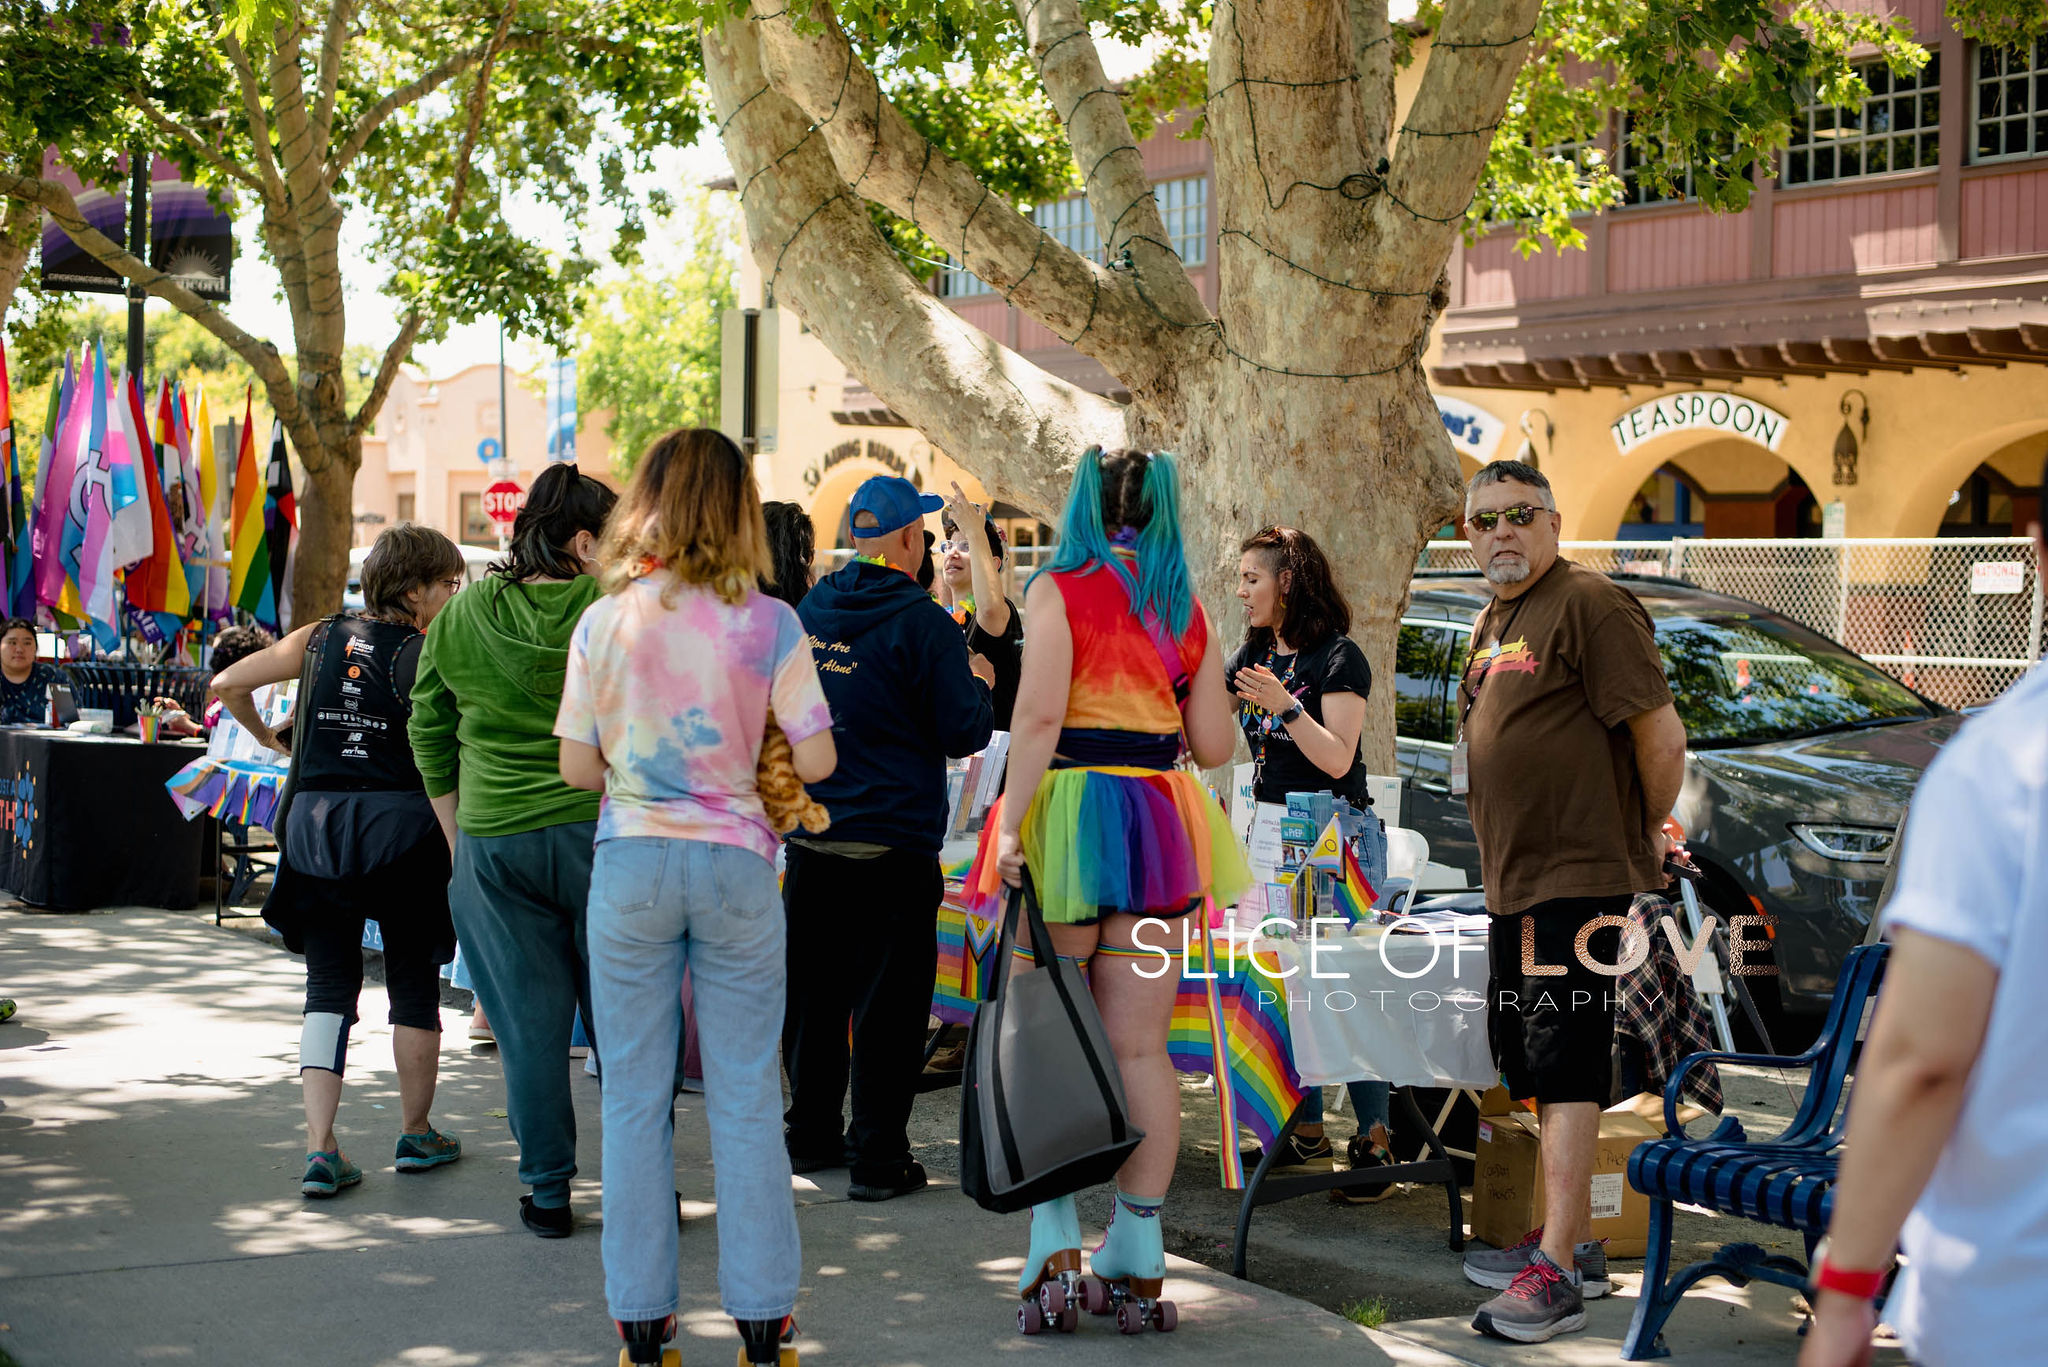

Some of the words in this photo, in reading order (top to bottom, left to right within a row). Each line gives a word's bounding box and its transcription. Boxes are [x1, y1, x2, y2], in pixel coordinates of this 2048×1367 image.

[1611, 396, 1779, 446] TEASPOON
[485, 492, 525, 513] STOP
[354, 641, 375, 651] PRIDE
[828, 641, 851, 653] Are
[820, 659, 858, 674] Alone"
